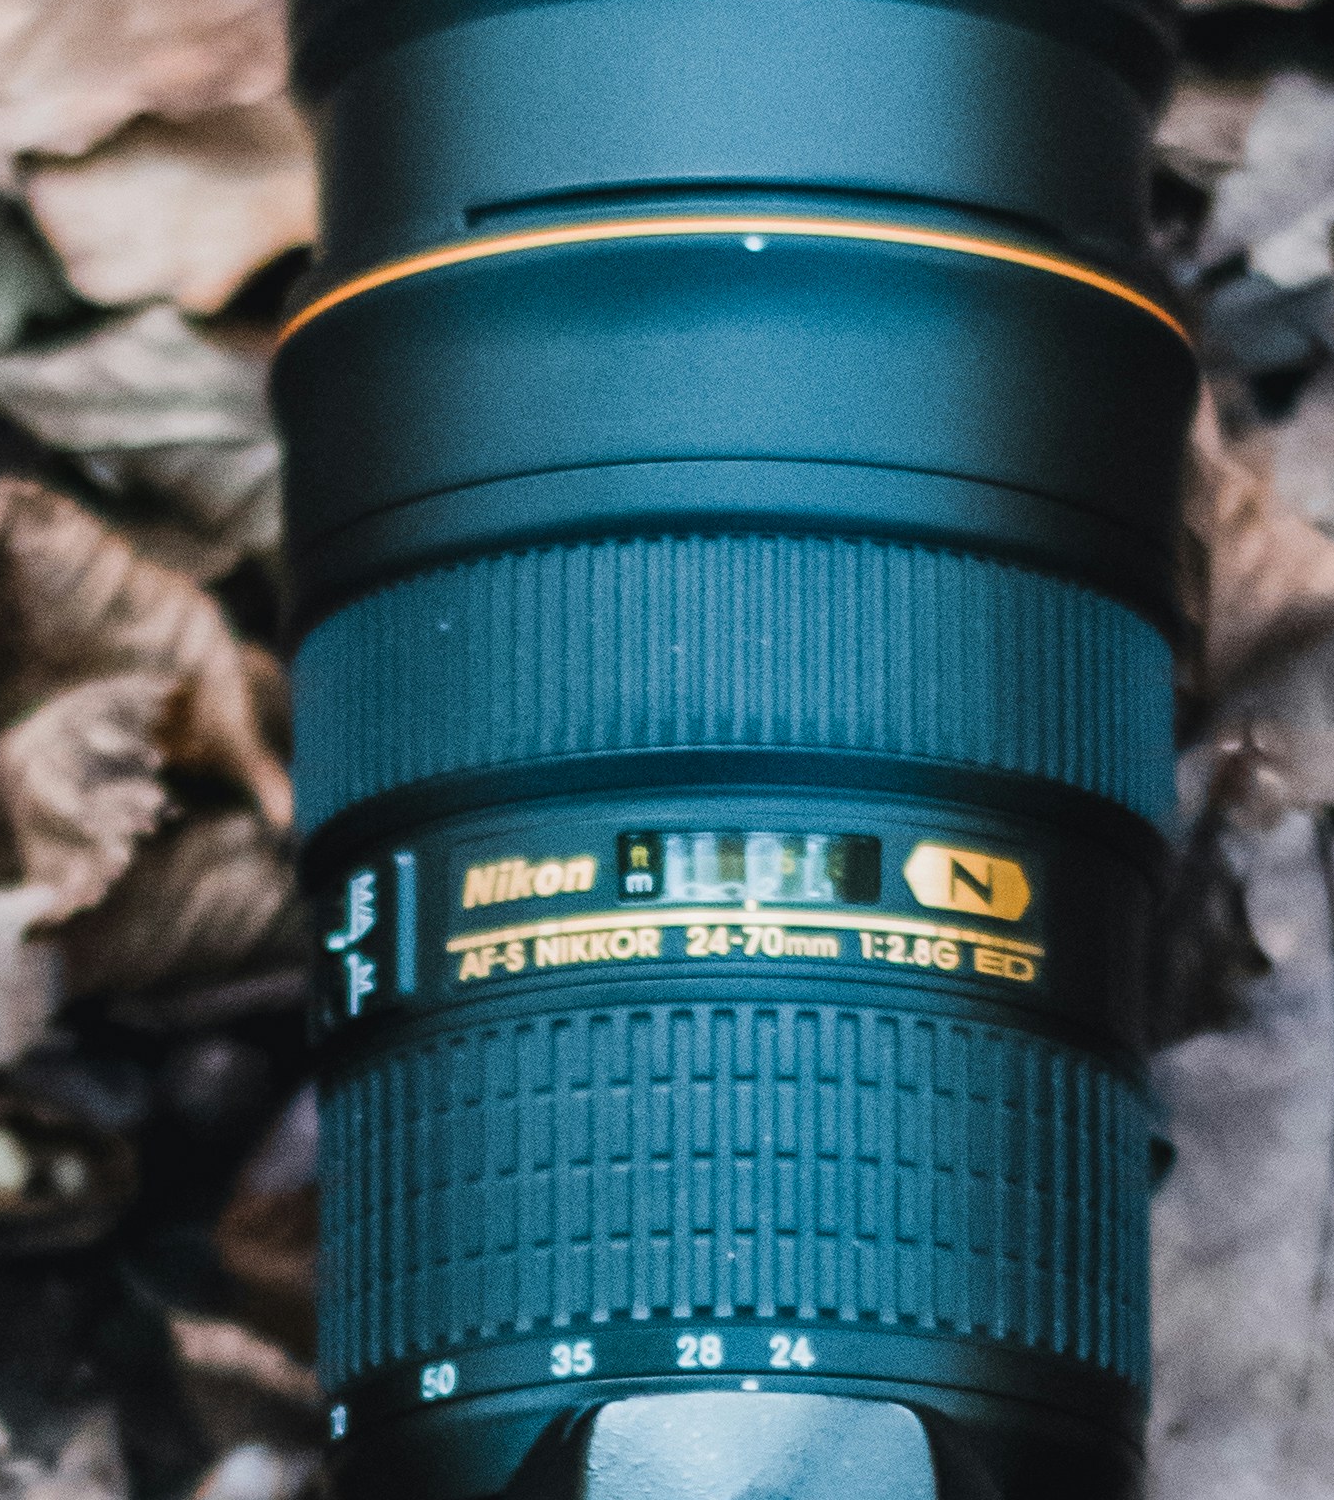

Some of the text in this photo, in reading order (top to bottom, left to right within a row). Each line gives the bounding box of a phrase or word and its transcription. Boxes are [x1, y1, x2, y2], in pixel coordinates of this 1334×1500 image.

[461, 855, 597, 911] Nikon
[457, 925, 1036, 983] AF-S NIKKOR 24-70mm 1:2.8G ED
[421, 1334, 817, 1399] 50 35 28 24
